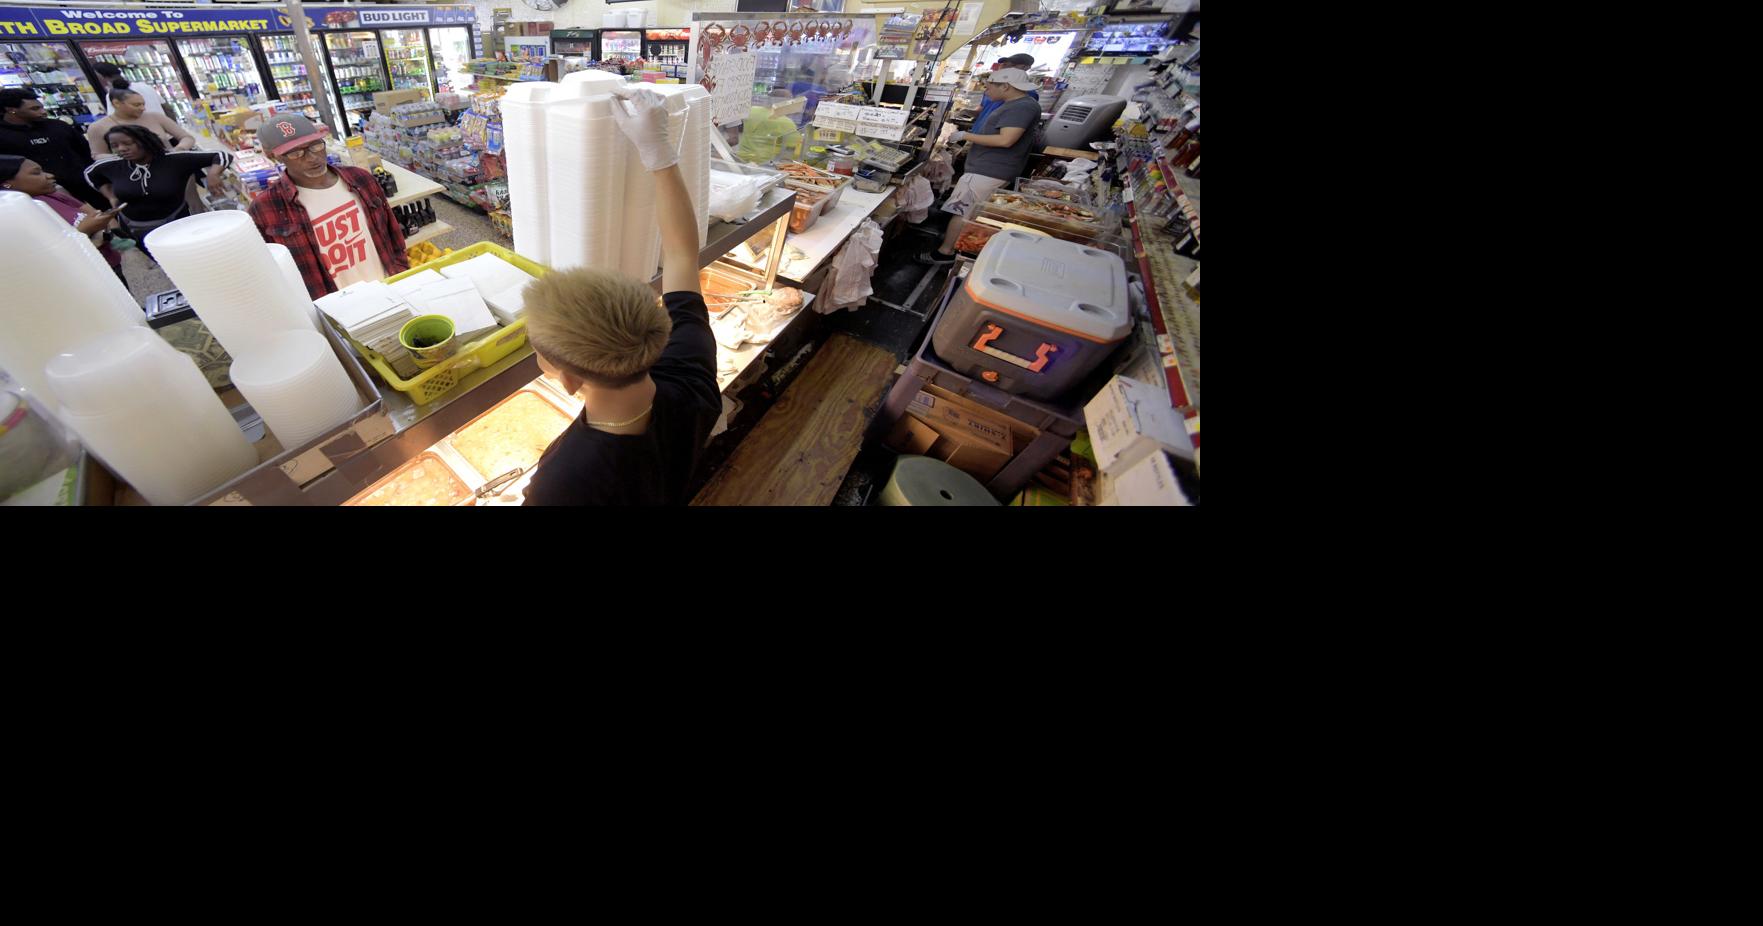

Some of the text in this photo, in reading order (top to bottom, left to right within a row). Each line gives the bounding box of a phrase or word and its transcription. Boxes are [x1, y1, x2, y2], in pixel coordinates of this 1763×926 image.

[60, 10, 184, 19] Welcome To
[362, 12, 391, 22] BUD
[392, 12, 426, 20] LIGHT
[276, 121, 296, 138] B
